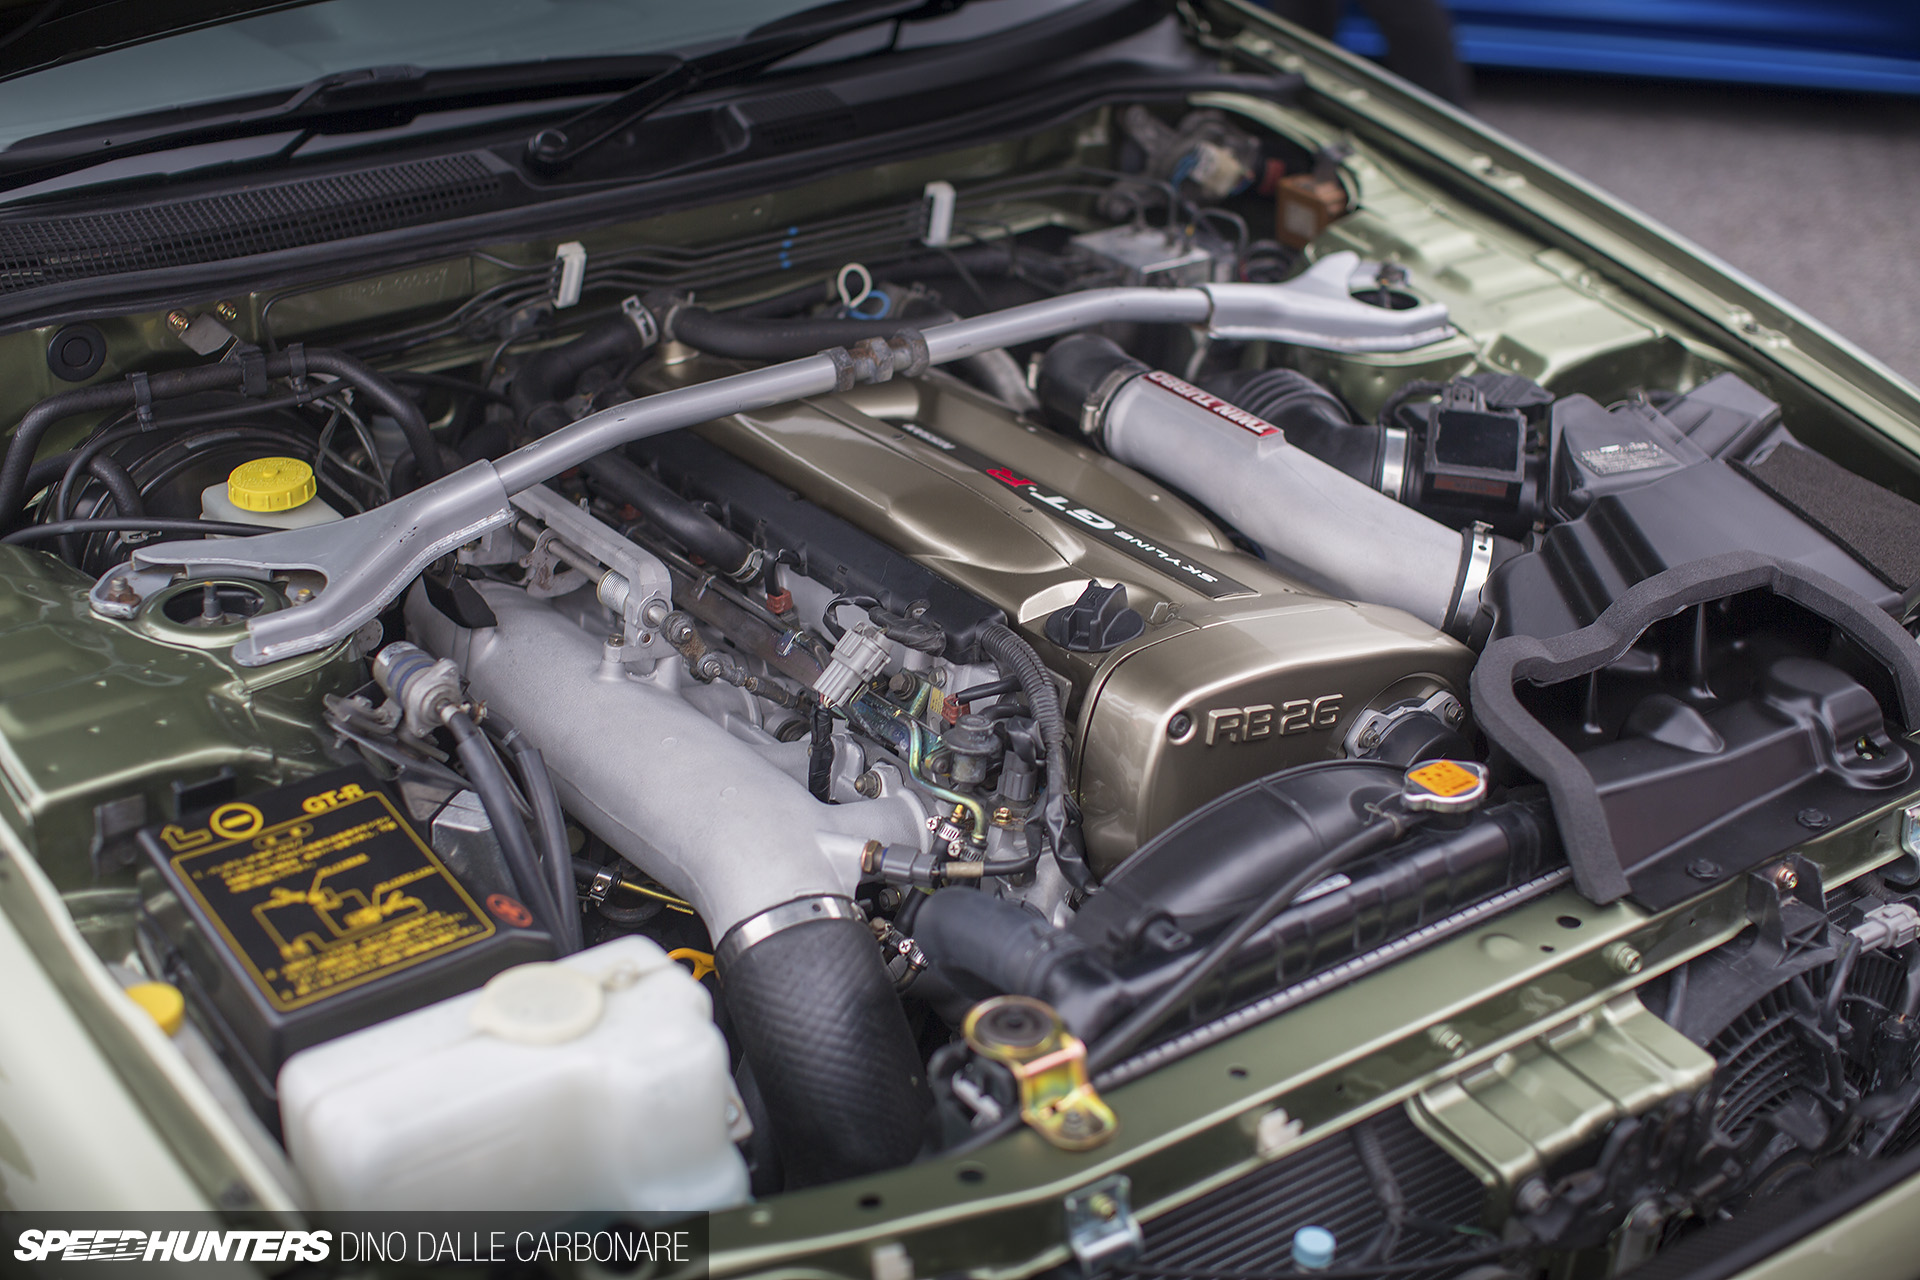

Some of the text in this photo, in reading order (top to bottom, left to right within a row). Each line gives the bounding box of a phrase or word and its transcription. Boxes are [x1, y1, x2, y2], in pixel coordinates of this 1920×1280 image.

[1147, 370, 1271, 435] TWIN TURBO
[1114, 529, 1219, 583] SKYLINE
[302, 783, 364, 814] GT-R
